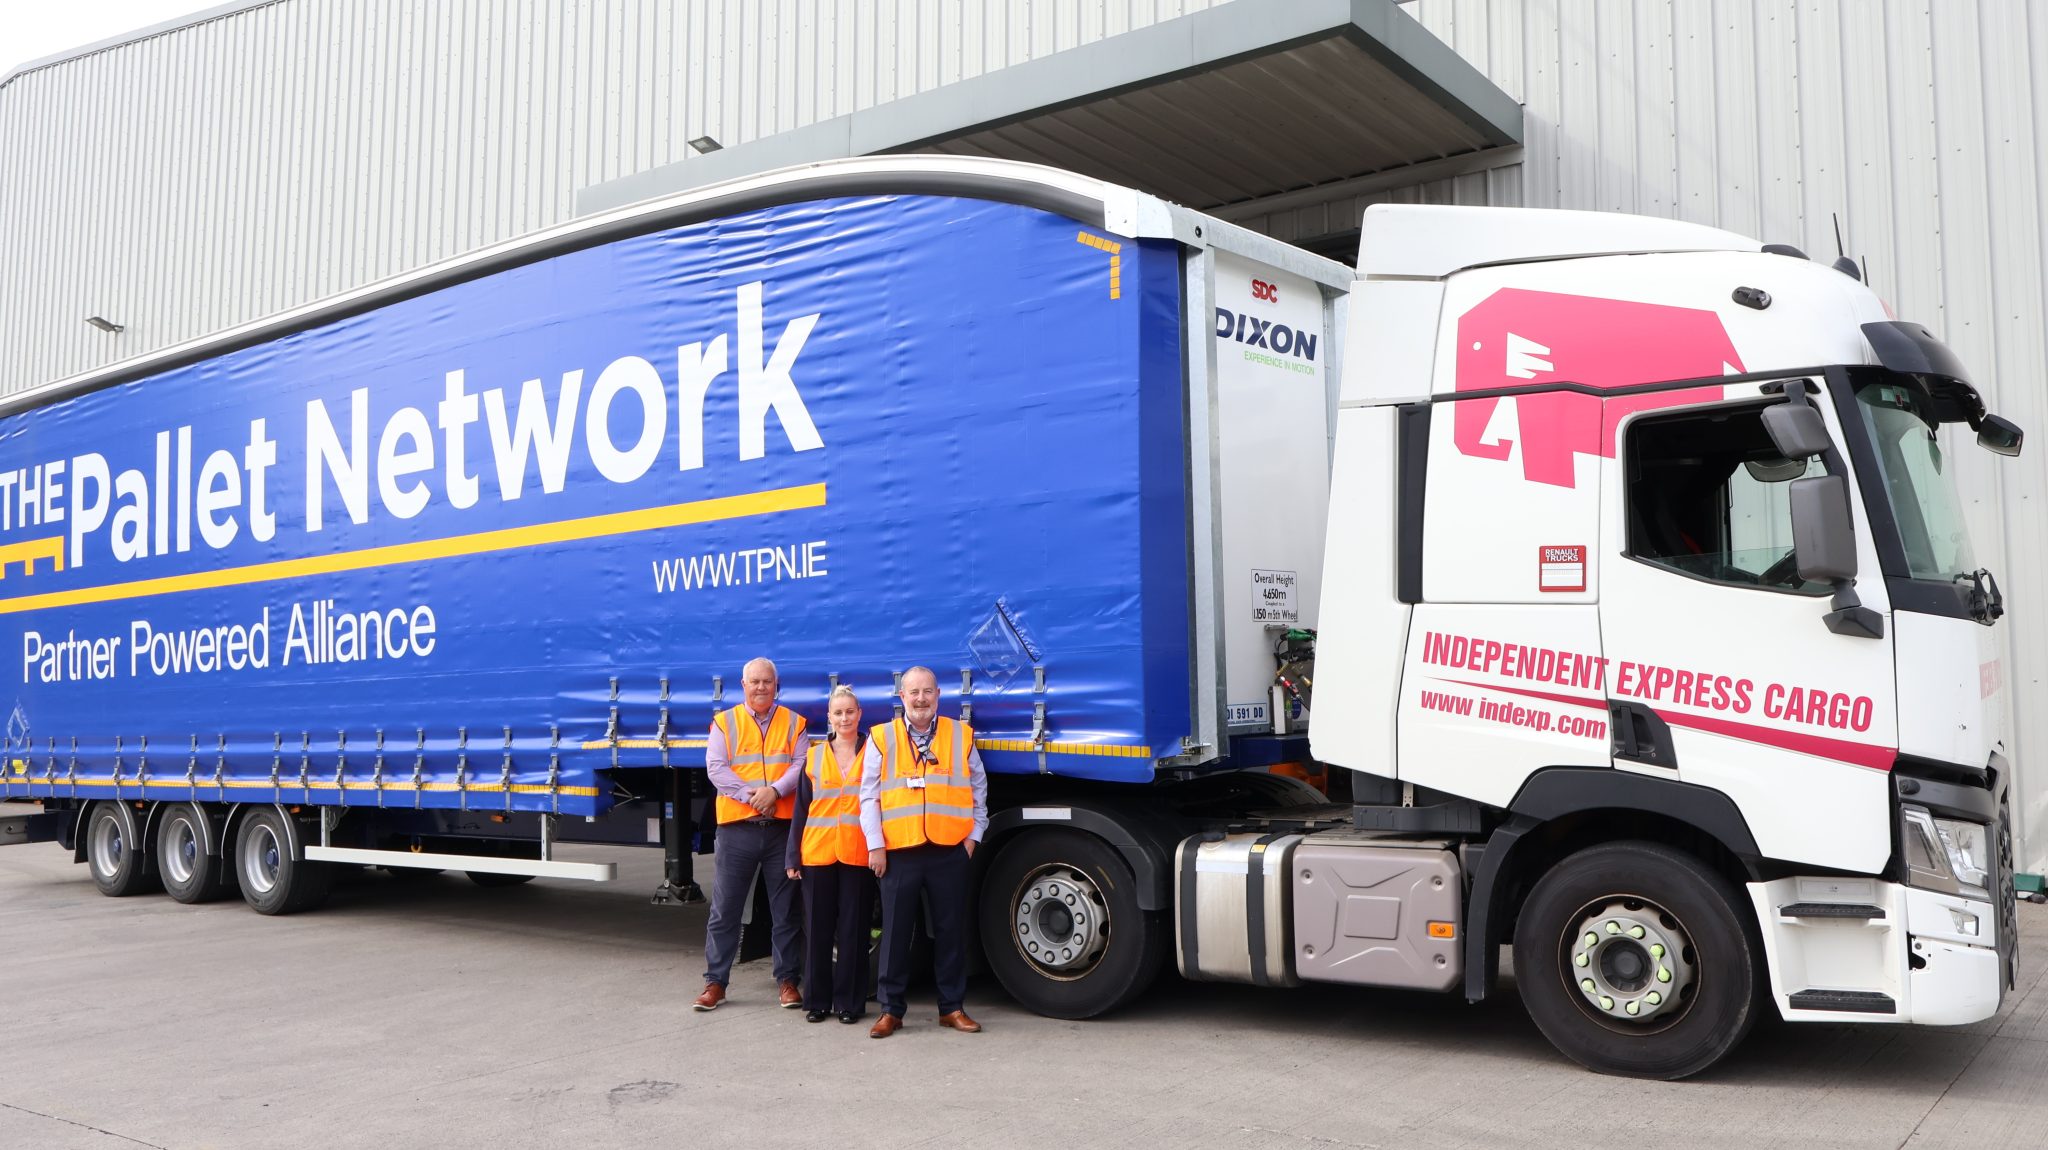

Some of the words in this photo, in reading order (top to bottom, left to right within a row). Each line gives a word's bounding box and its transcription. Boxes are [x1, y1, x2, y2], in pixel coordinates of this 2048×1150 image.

[1252, 278, 1278, 303] SDC
[1215, 307, 1317, 361] DIXON
[1244, 350, 1283, 369] EXPERIENCE
[1283, 362, 1291, 371] IN
[1291, 363, 1315, 377] MOTION
[0, 459, 66, 531] THE
[70, 418, 277, 569] Pallet
[306, 281, 825, 532] Network
[1545, 548, 1579, 556] RENAULT
[1545, 554, 1579, 562] TRUCKS
[653, 540, 828, 593] WWW.TPN.IE
[1254, 572, 1275, 583] Overall
[1275, 573, 1294, 588] Height
[1262, 588, 1287, 600] 4.650m
[1281, 609, 1298, 620] Wheel
[24, 630, 121, 683] Partner
[131, 606, 269, 677] Powered
[282, 599, 436, 666] Alliance
[1422, 631, 1610, 691] INDEPENDENT
[1616, 661, 1754, 714] EXPRESS
[1763, 683, 1874, 732] CARGO
[1236, 707, 1250, 719] 591
[1253, 706, 1264, 718] DD
[1420, 690, 1474, 716] www
[1478, 697, 1607, 740] indexp.com
